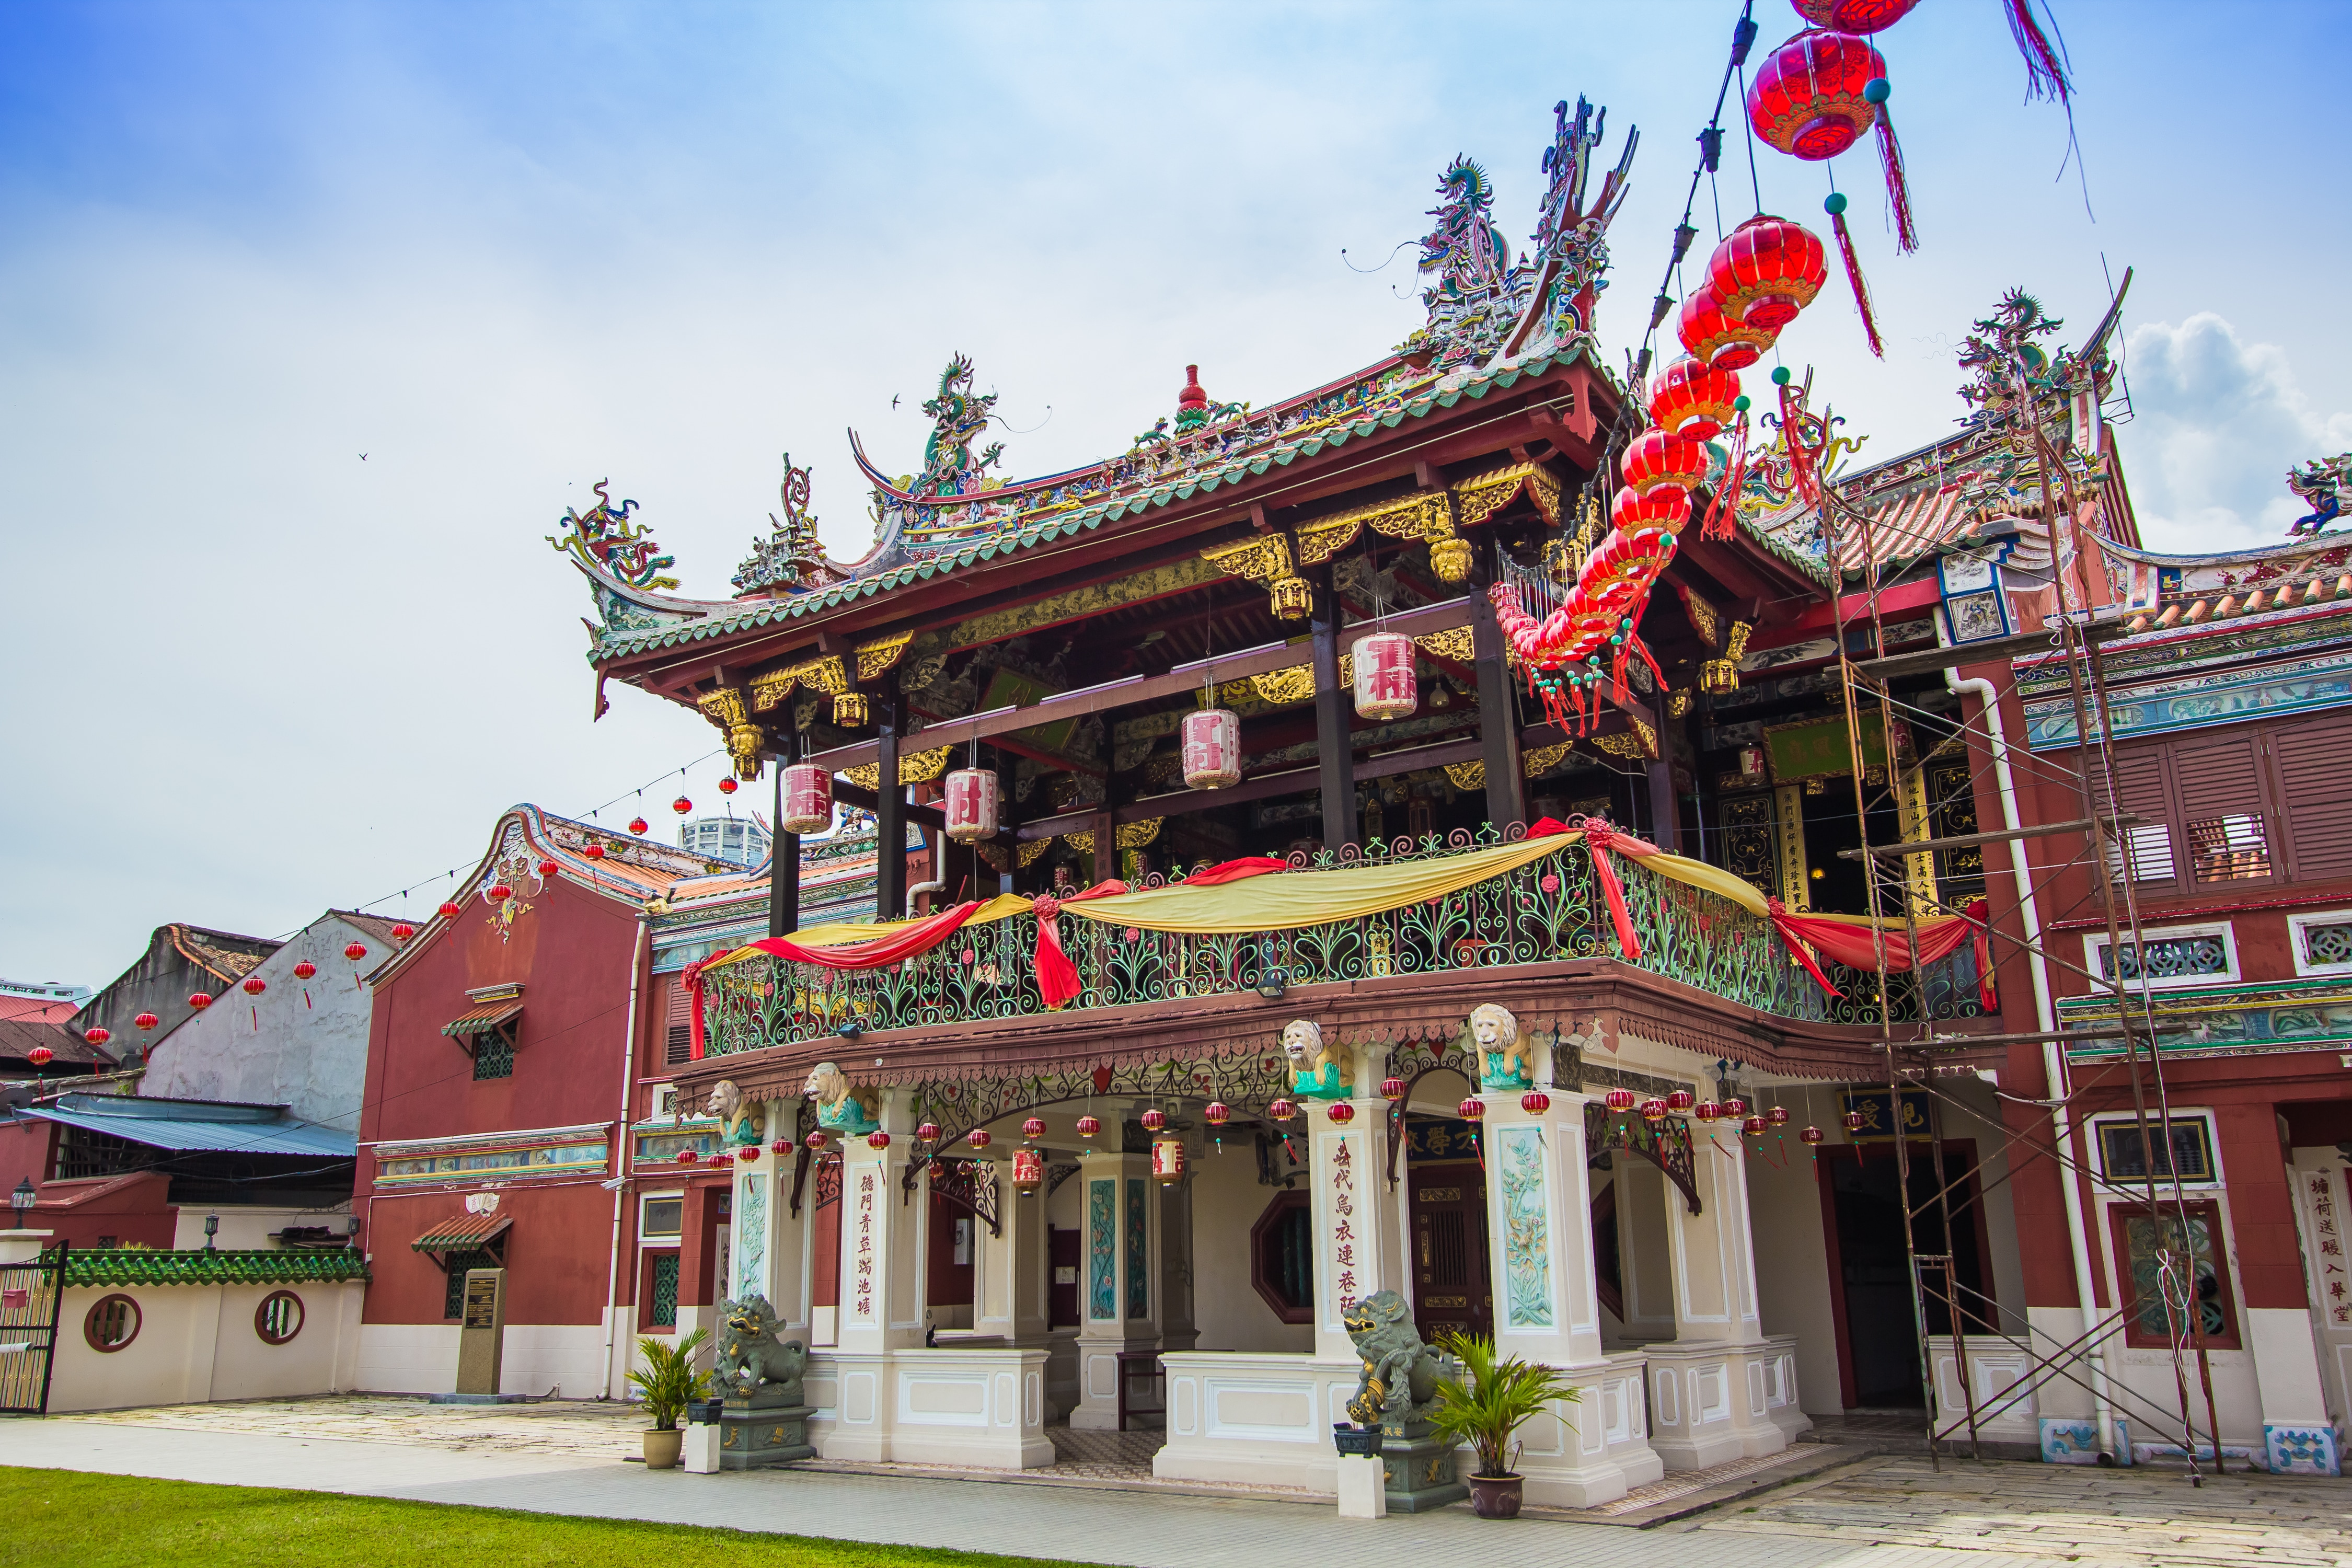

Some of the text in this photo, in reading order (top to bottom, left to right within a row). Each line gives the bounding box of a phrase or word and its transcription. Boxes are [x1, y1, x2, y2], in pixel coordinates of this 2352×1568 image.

[857, 1174, 874, 1316] 德門青草滿池塘
